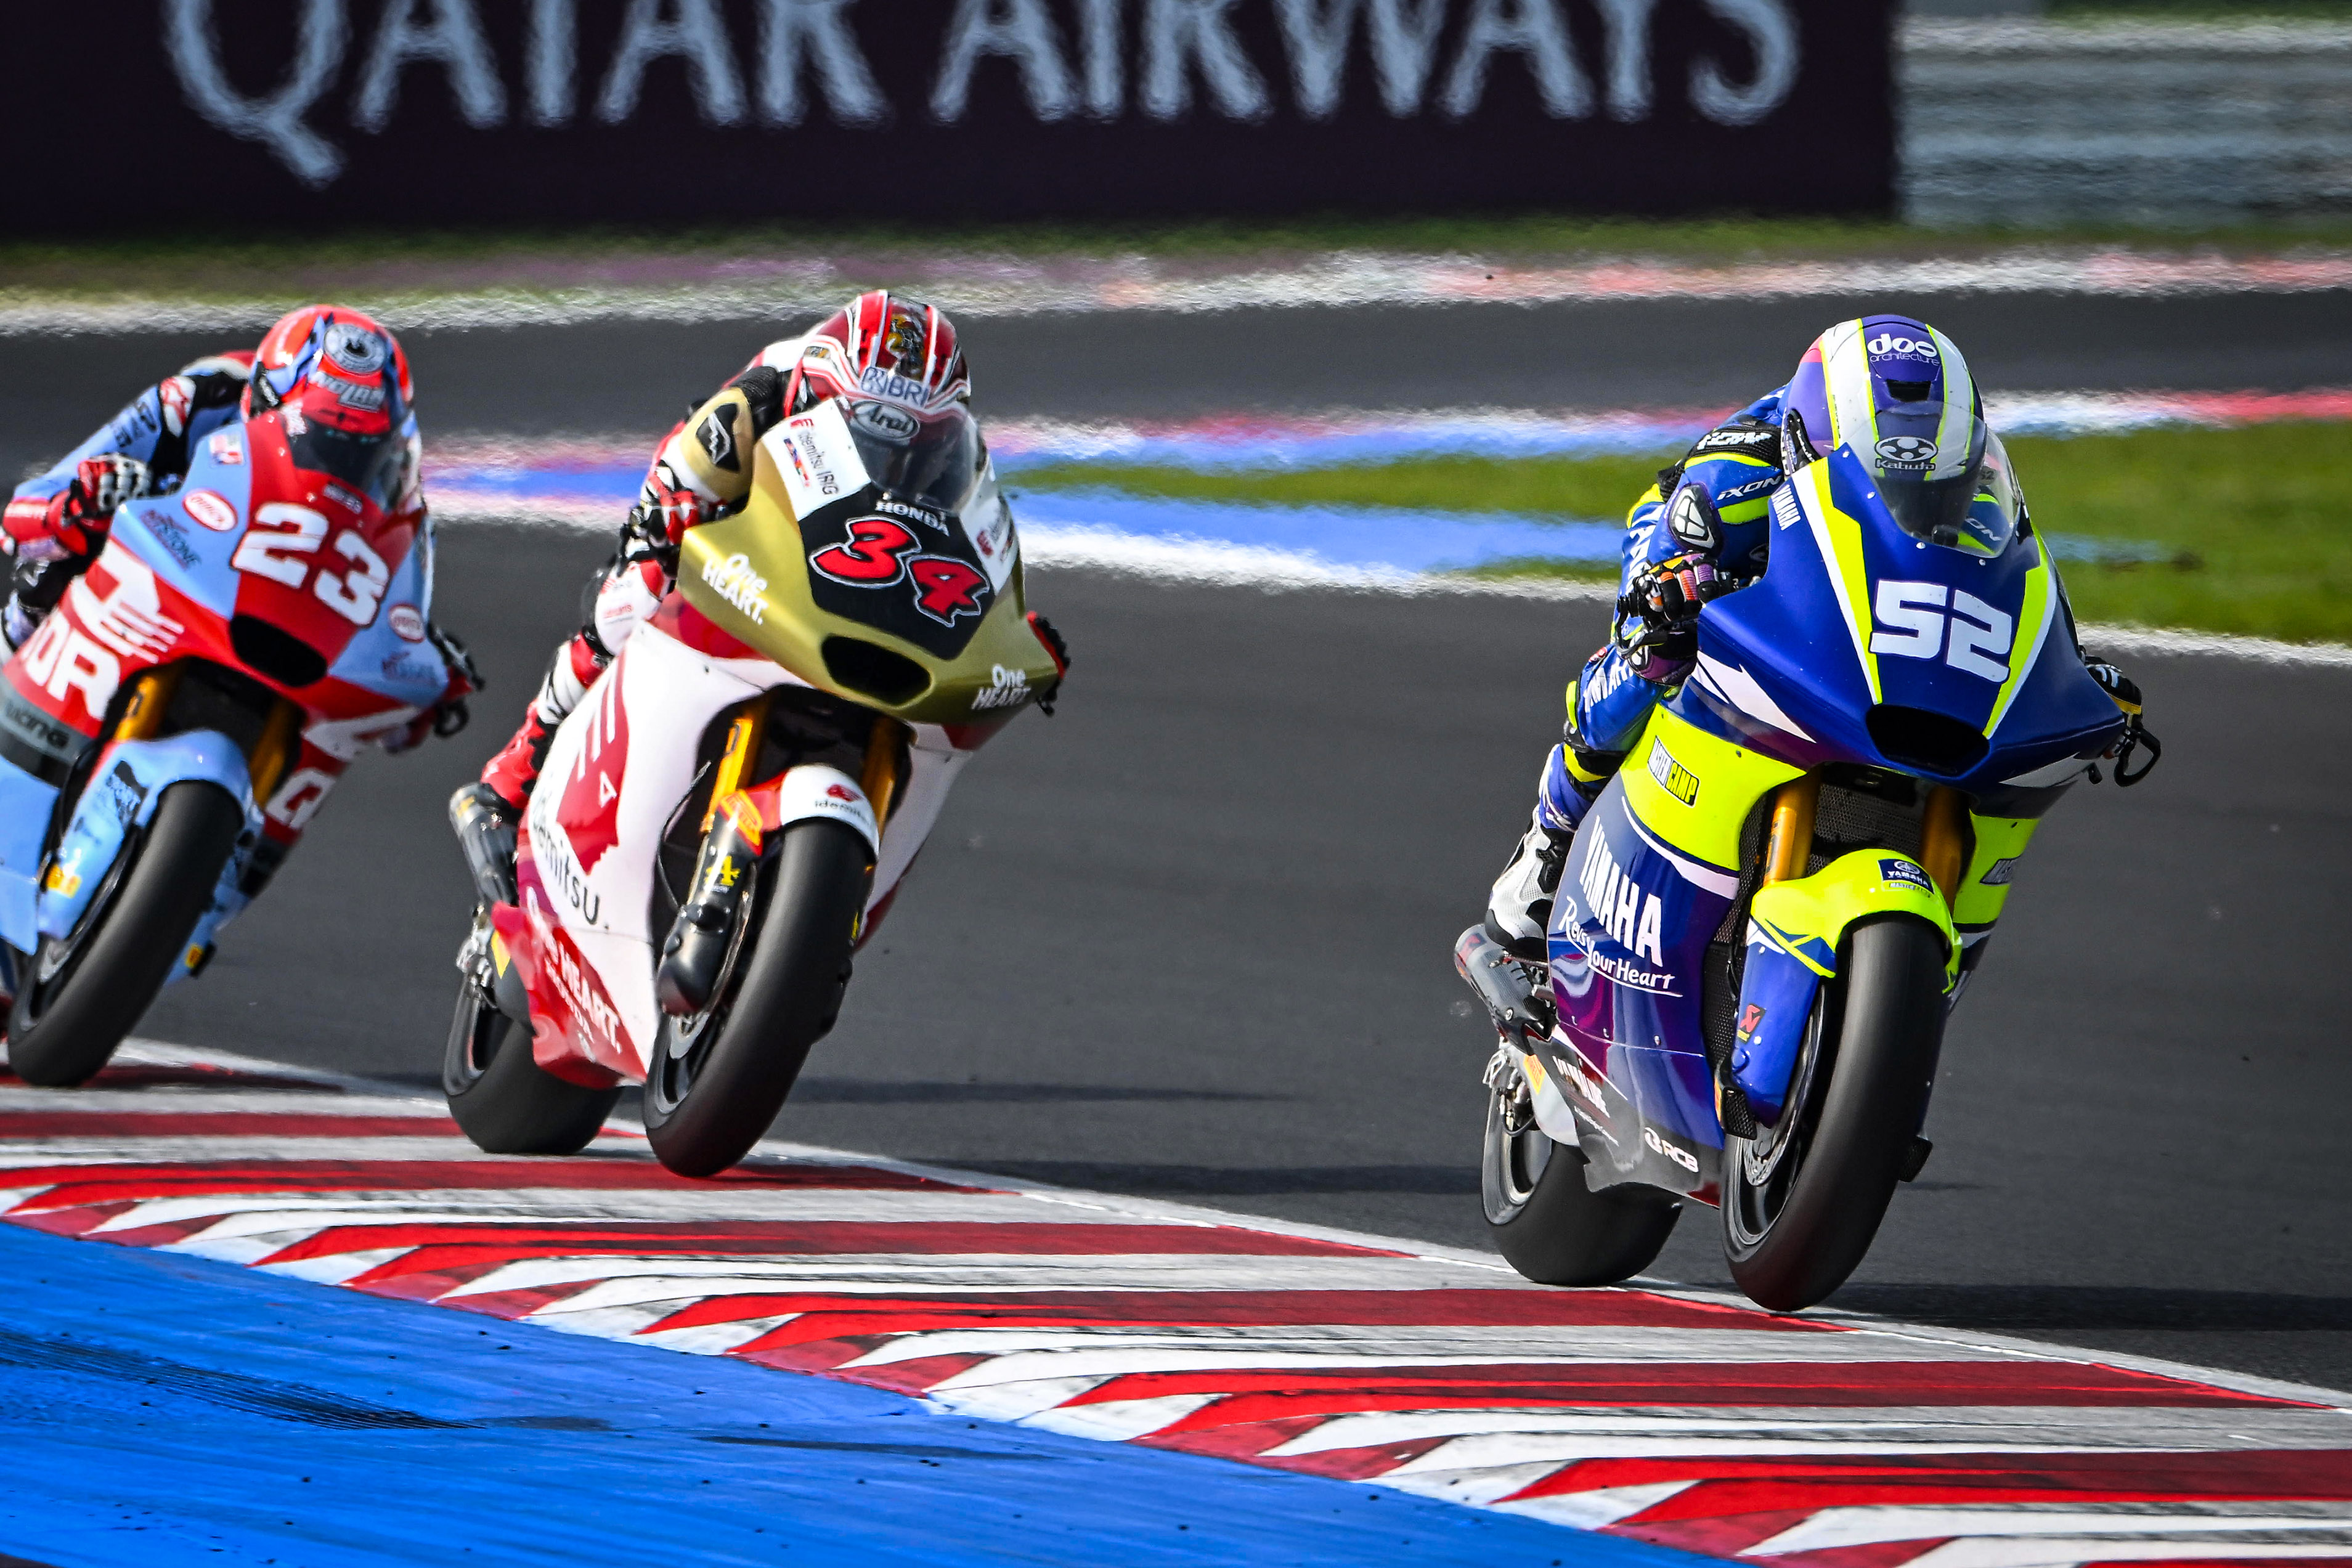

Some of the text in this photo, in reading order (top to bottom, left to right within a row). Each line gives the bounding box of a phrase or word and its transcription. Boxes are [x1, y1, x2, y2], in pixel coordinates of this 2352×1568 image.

[1870, 352, 1941, 366] architecture
[1876, 459, 1935, 470] Kabuto
[875, 500, 950, 536] HONDA
[1770, 484, 1802, 531] YAMAHA
[1964, 518, 2003, 542] ON
[231, 502, 391, 627] 23
[727, 553, 768, 593] One
[808, 517, 989, 627] 34
[1870, 579, 2012, 683] 52
[992, 664, 1026, 688] One
[1666, 762, 1699, 803] CAMP
[1579, 814, 1663, 967] YAMAHA
[1887, 871, 1929, 887] YAMAHA
[1558, 895, 1675, 989] Revs Your Heart
